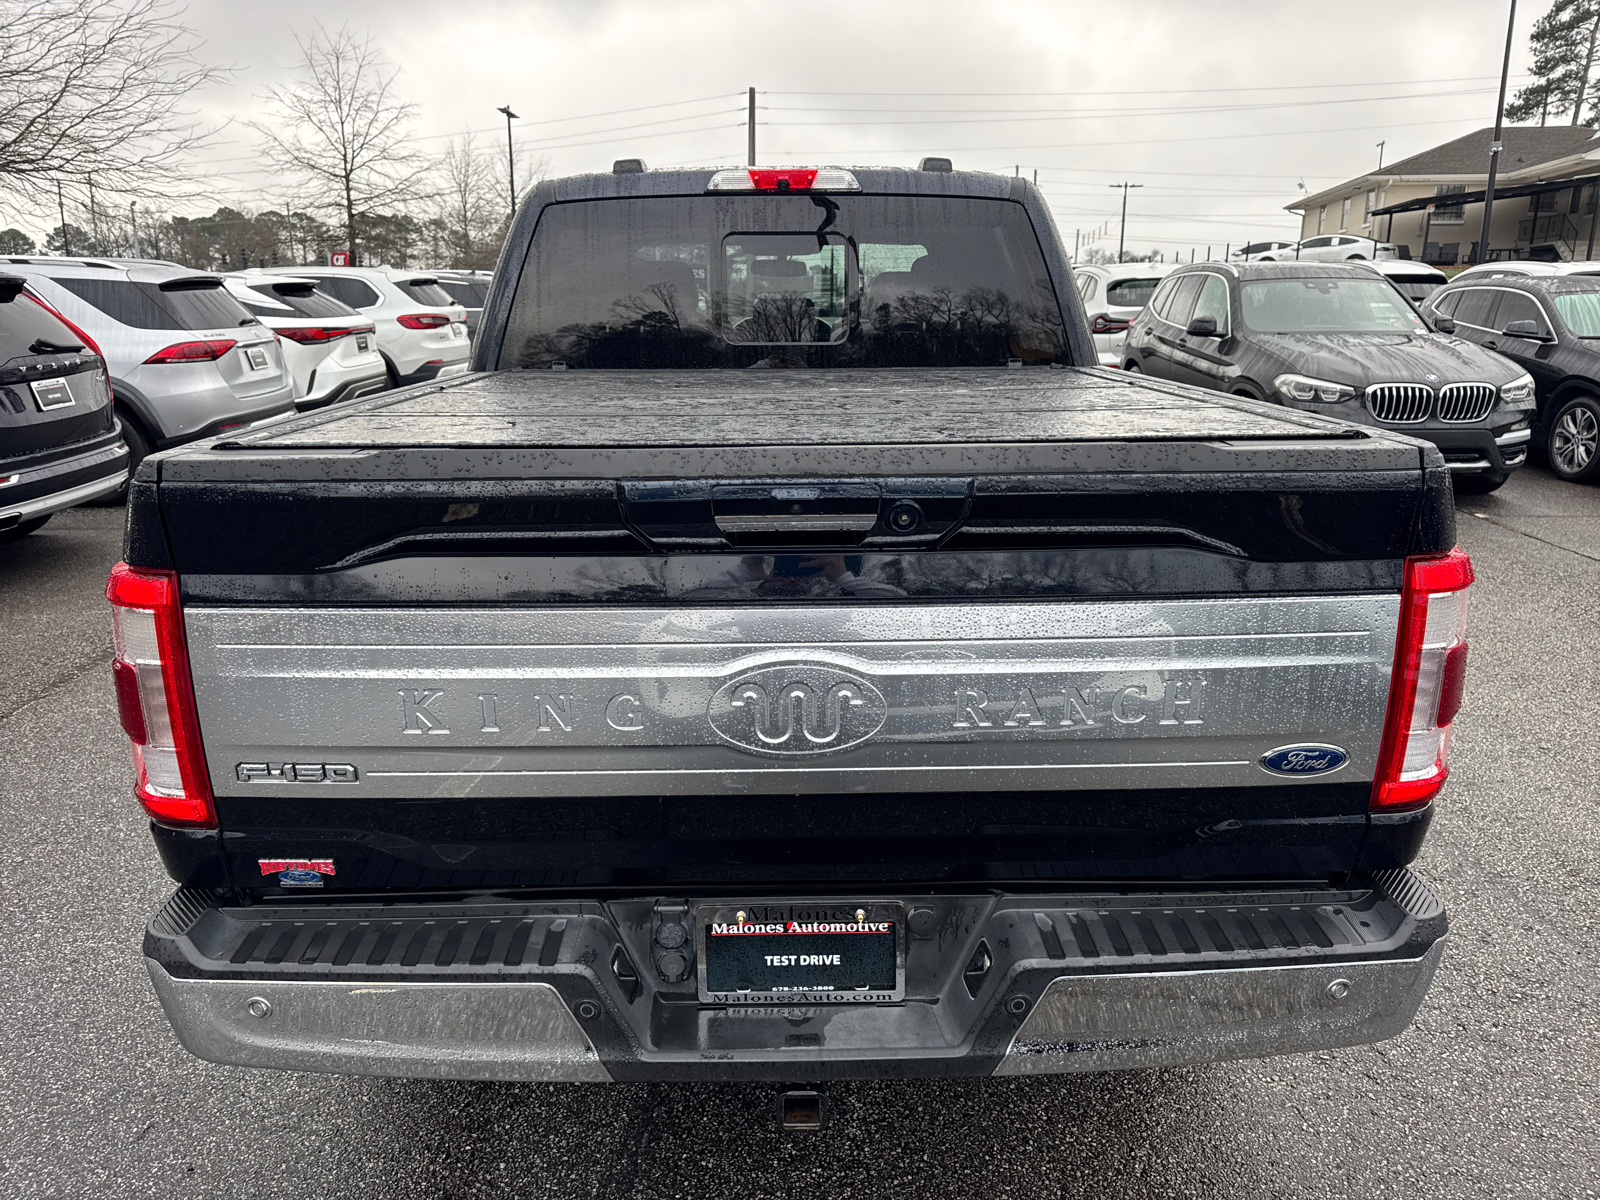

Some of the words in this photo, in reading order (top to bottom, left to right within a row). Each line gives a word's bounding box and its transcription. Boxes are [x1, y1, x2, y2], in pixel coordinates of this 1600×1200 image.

[19, 358, 80, 373] VOLVO
[398, 688, 645, 735] KING
[952, 679, 1207, 728] RANCH
[1281, 751, 1331, 770] Ford
[235, 762, 359, 784] F-150
[747, 906, 857, 922] Malones
[711, 922, 784, 935] Malones
[787, 921, 889, 934] Automotive
[764, 955, 797, 967] TEST
[800, 954, 841, 966] DRIVE
[712, 992, 893, 1003] MalonesAuto.com
